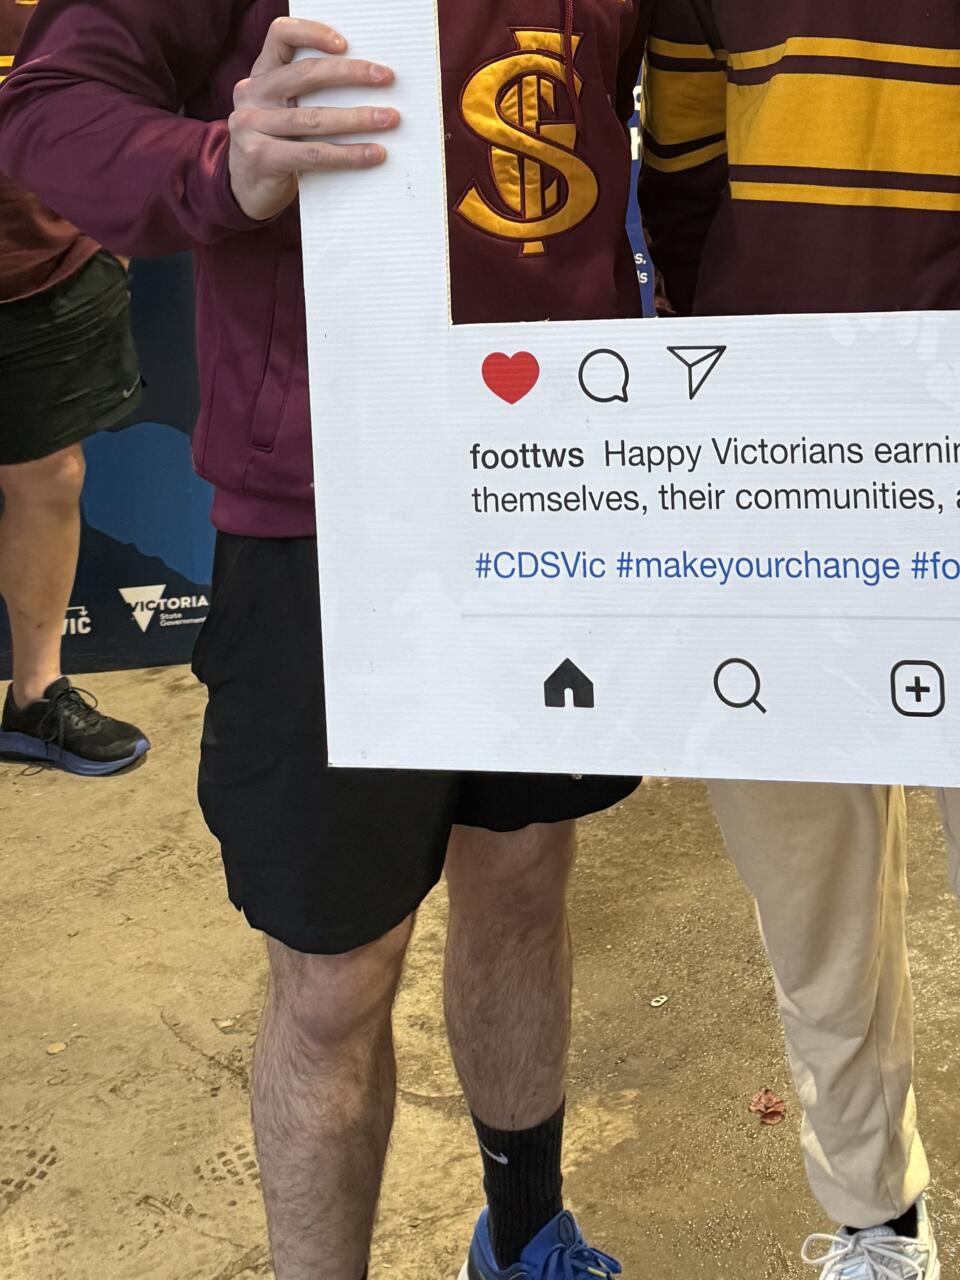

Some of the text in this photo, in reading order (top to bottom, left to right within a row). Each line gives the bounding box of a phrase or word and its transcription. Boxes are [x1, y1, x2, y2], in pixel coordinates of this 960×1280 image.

[470, 443, 584, 469] foottws
[605, 440, 702, 472] Happy
[712, 437, 863, 465] Victorians
[471, 485, 648, 515] themselves,
[658, 483, 725, 510] their
[735, 481, 944, 514] communities,
[475, 551, 606, 578] #CDSVic
[616, 551, 900, 585] #makeyourchange
[128, 595, 209, 612] VICTORIA
